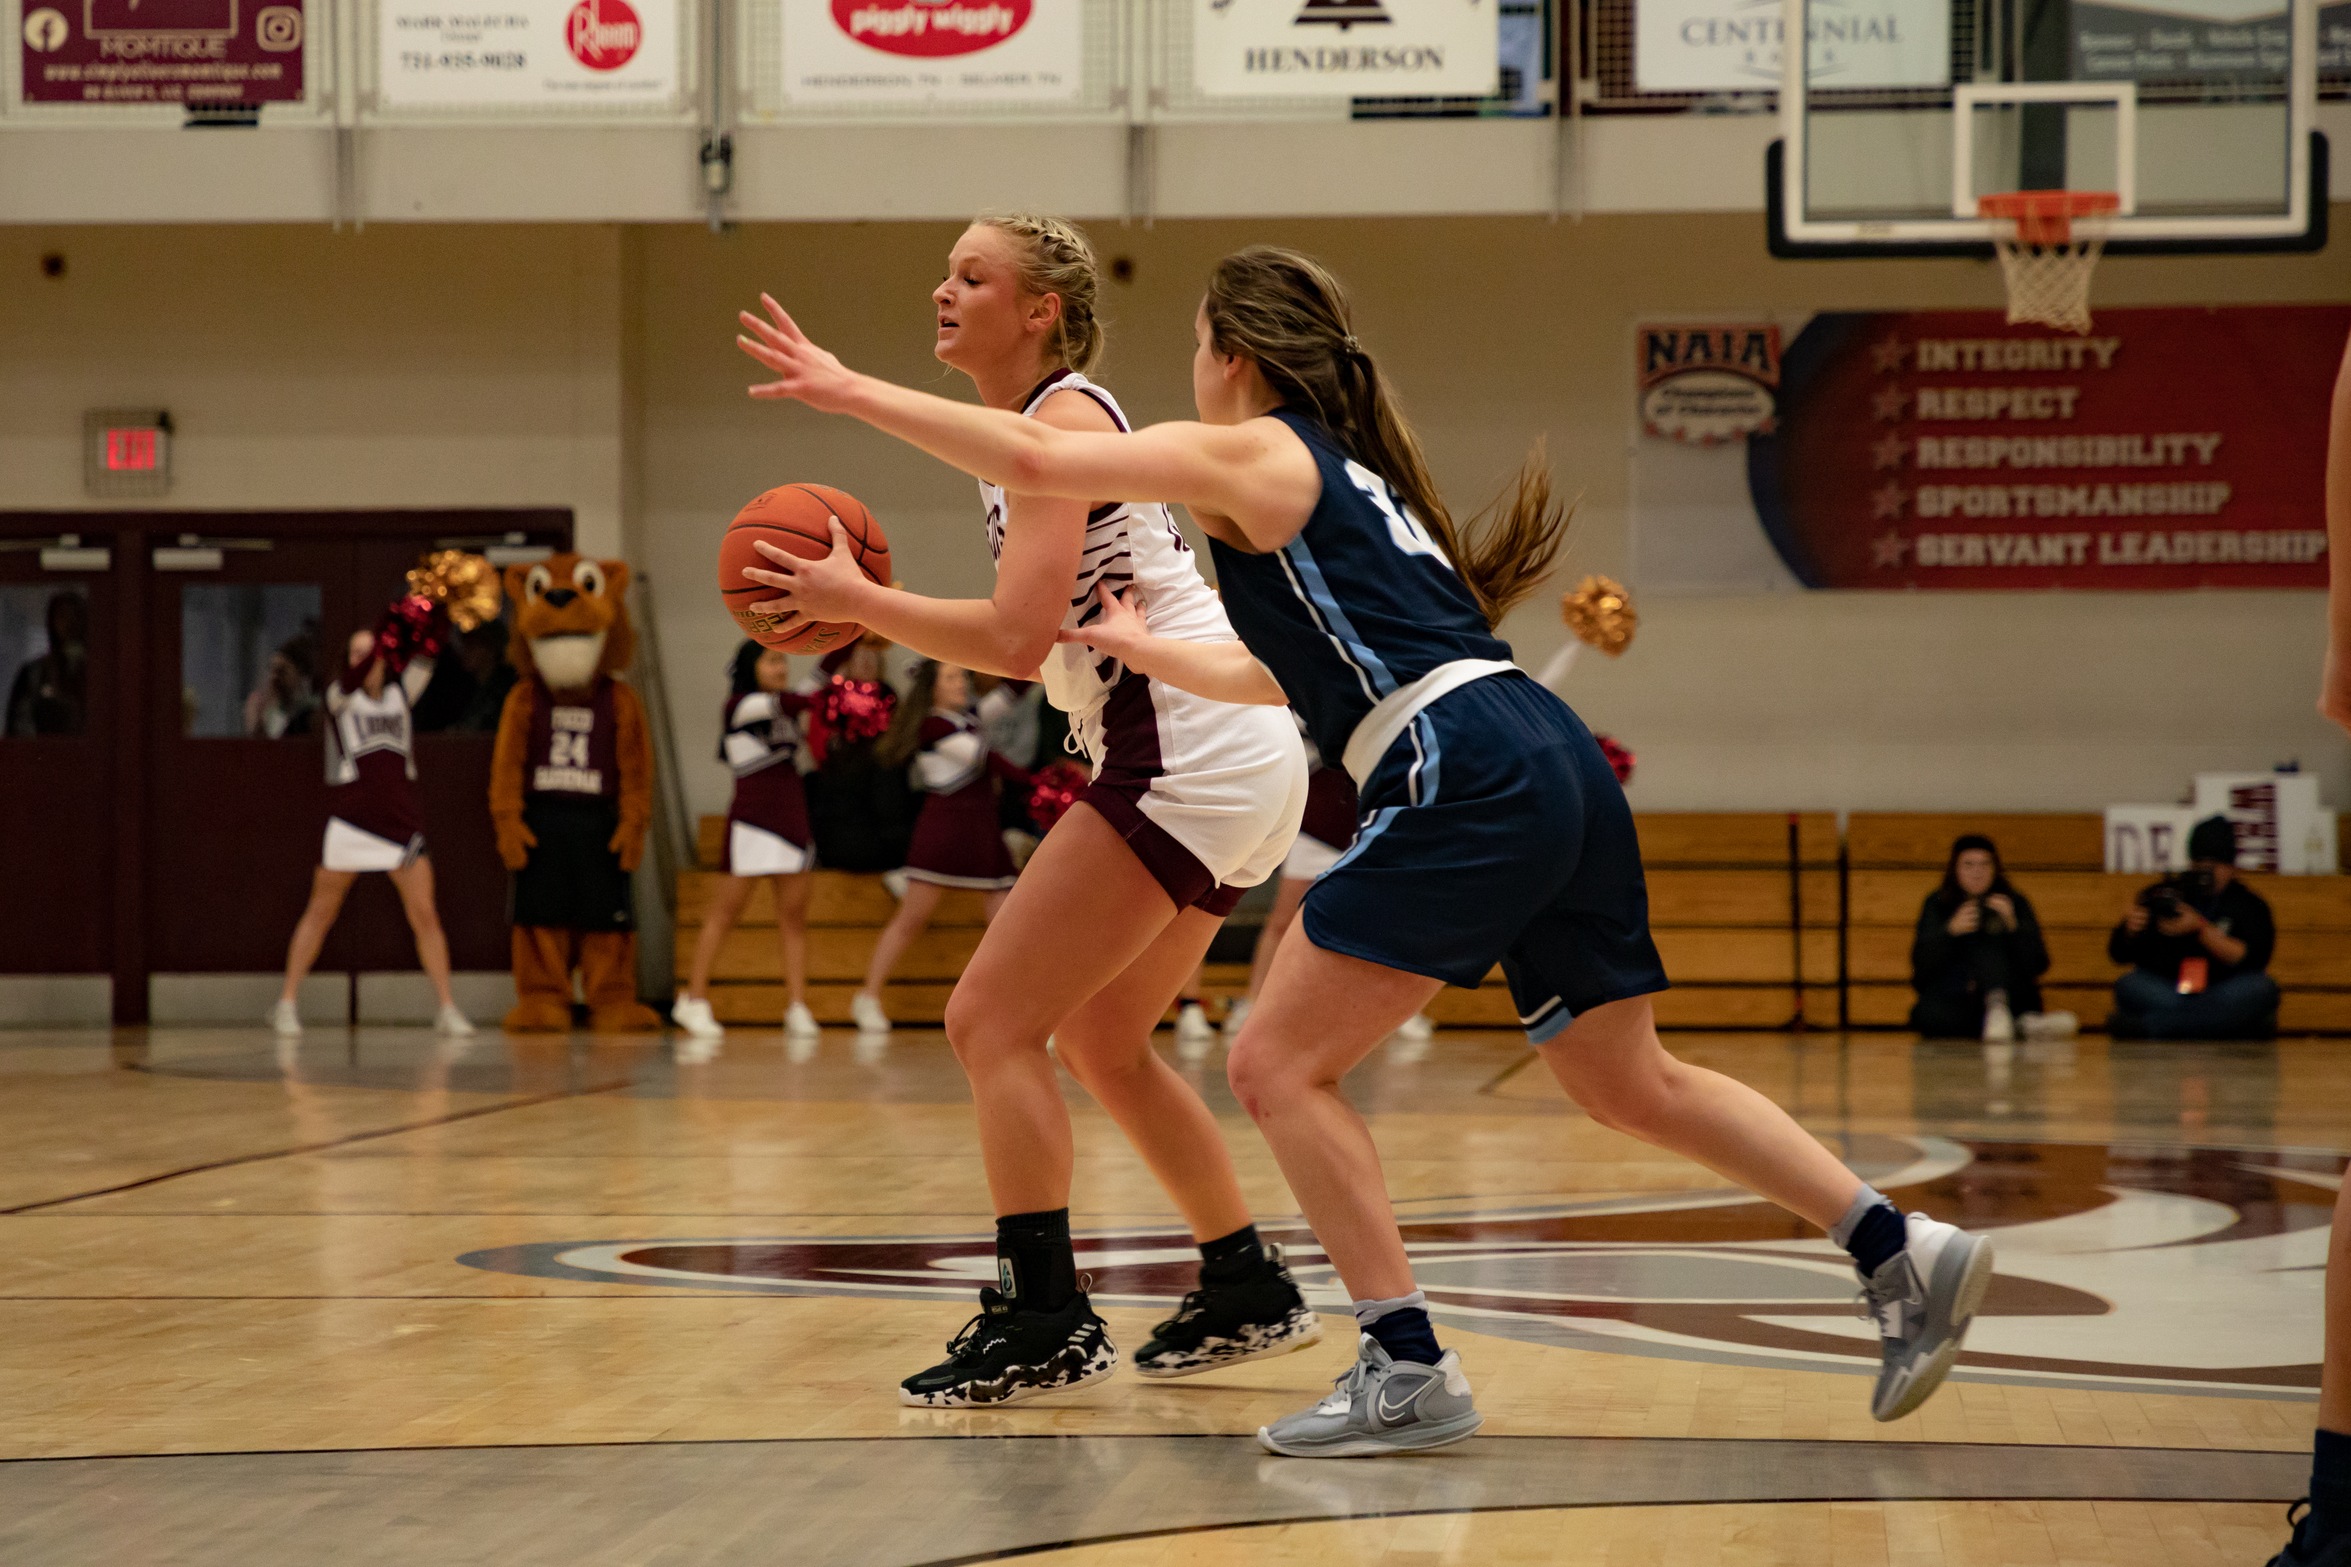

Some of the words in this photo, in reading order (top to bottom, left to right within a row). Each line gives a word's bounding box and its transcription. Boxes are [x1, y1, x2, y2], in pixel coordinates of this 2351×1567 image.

[571, 0, 637, 61] Rheem
[850, 5, 929, 37] piggly
[931, 4, 1014, 36] wiggly
[101, 37, 228, 58] MOMTIQUE
[1244, 47, 1446, 73] HENDERSON
[1646, 332, 1772, 373] NAIA
[1917, 338, 2120, 371] INTEGRITY
[1917, 387, 2080, 420] RESPECT
[107, 427, 156, 470] EXIT
[1917, 433, 2222, 469] RESPONSIBILITY
[1917, 482, 2231, 517] SPORTSMANSHIP
[1917, 532, 2093, 566] SERVANT
[2099, 529, 2329, 565] LEADERSHIP
[549, 731, 589, 769] 24
